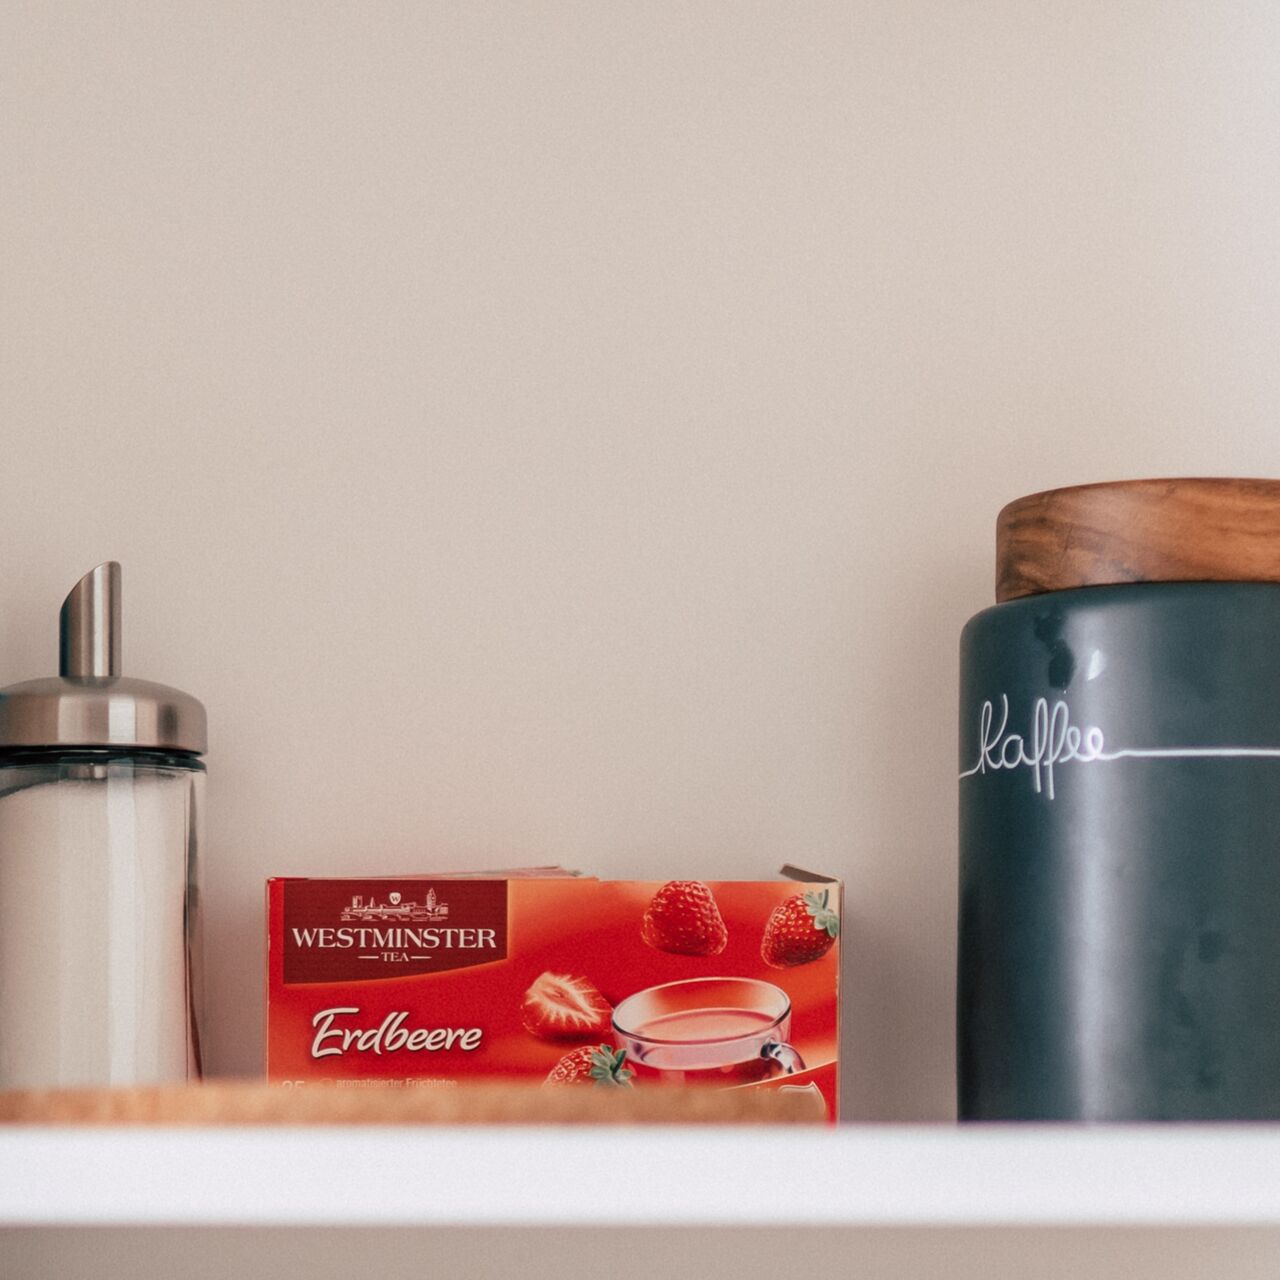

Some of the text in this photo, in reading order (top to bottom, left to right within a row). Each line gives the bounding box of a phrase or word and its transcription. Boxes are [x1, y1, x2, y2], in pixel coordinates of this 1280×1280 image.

[976, 693, 1110, 800] Kaffee
[291, 927, 497, 949] WESTMINSTER
[381, 951, 410, 962] TEA
[310, 1006, 484, 1059] Erdbeere
